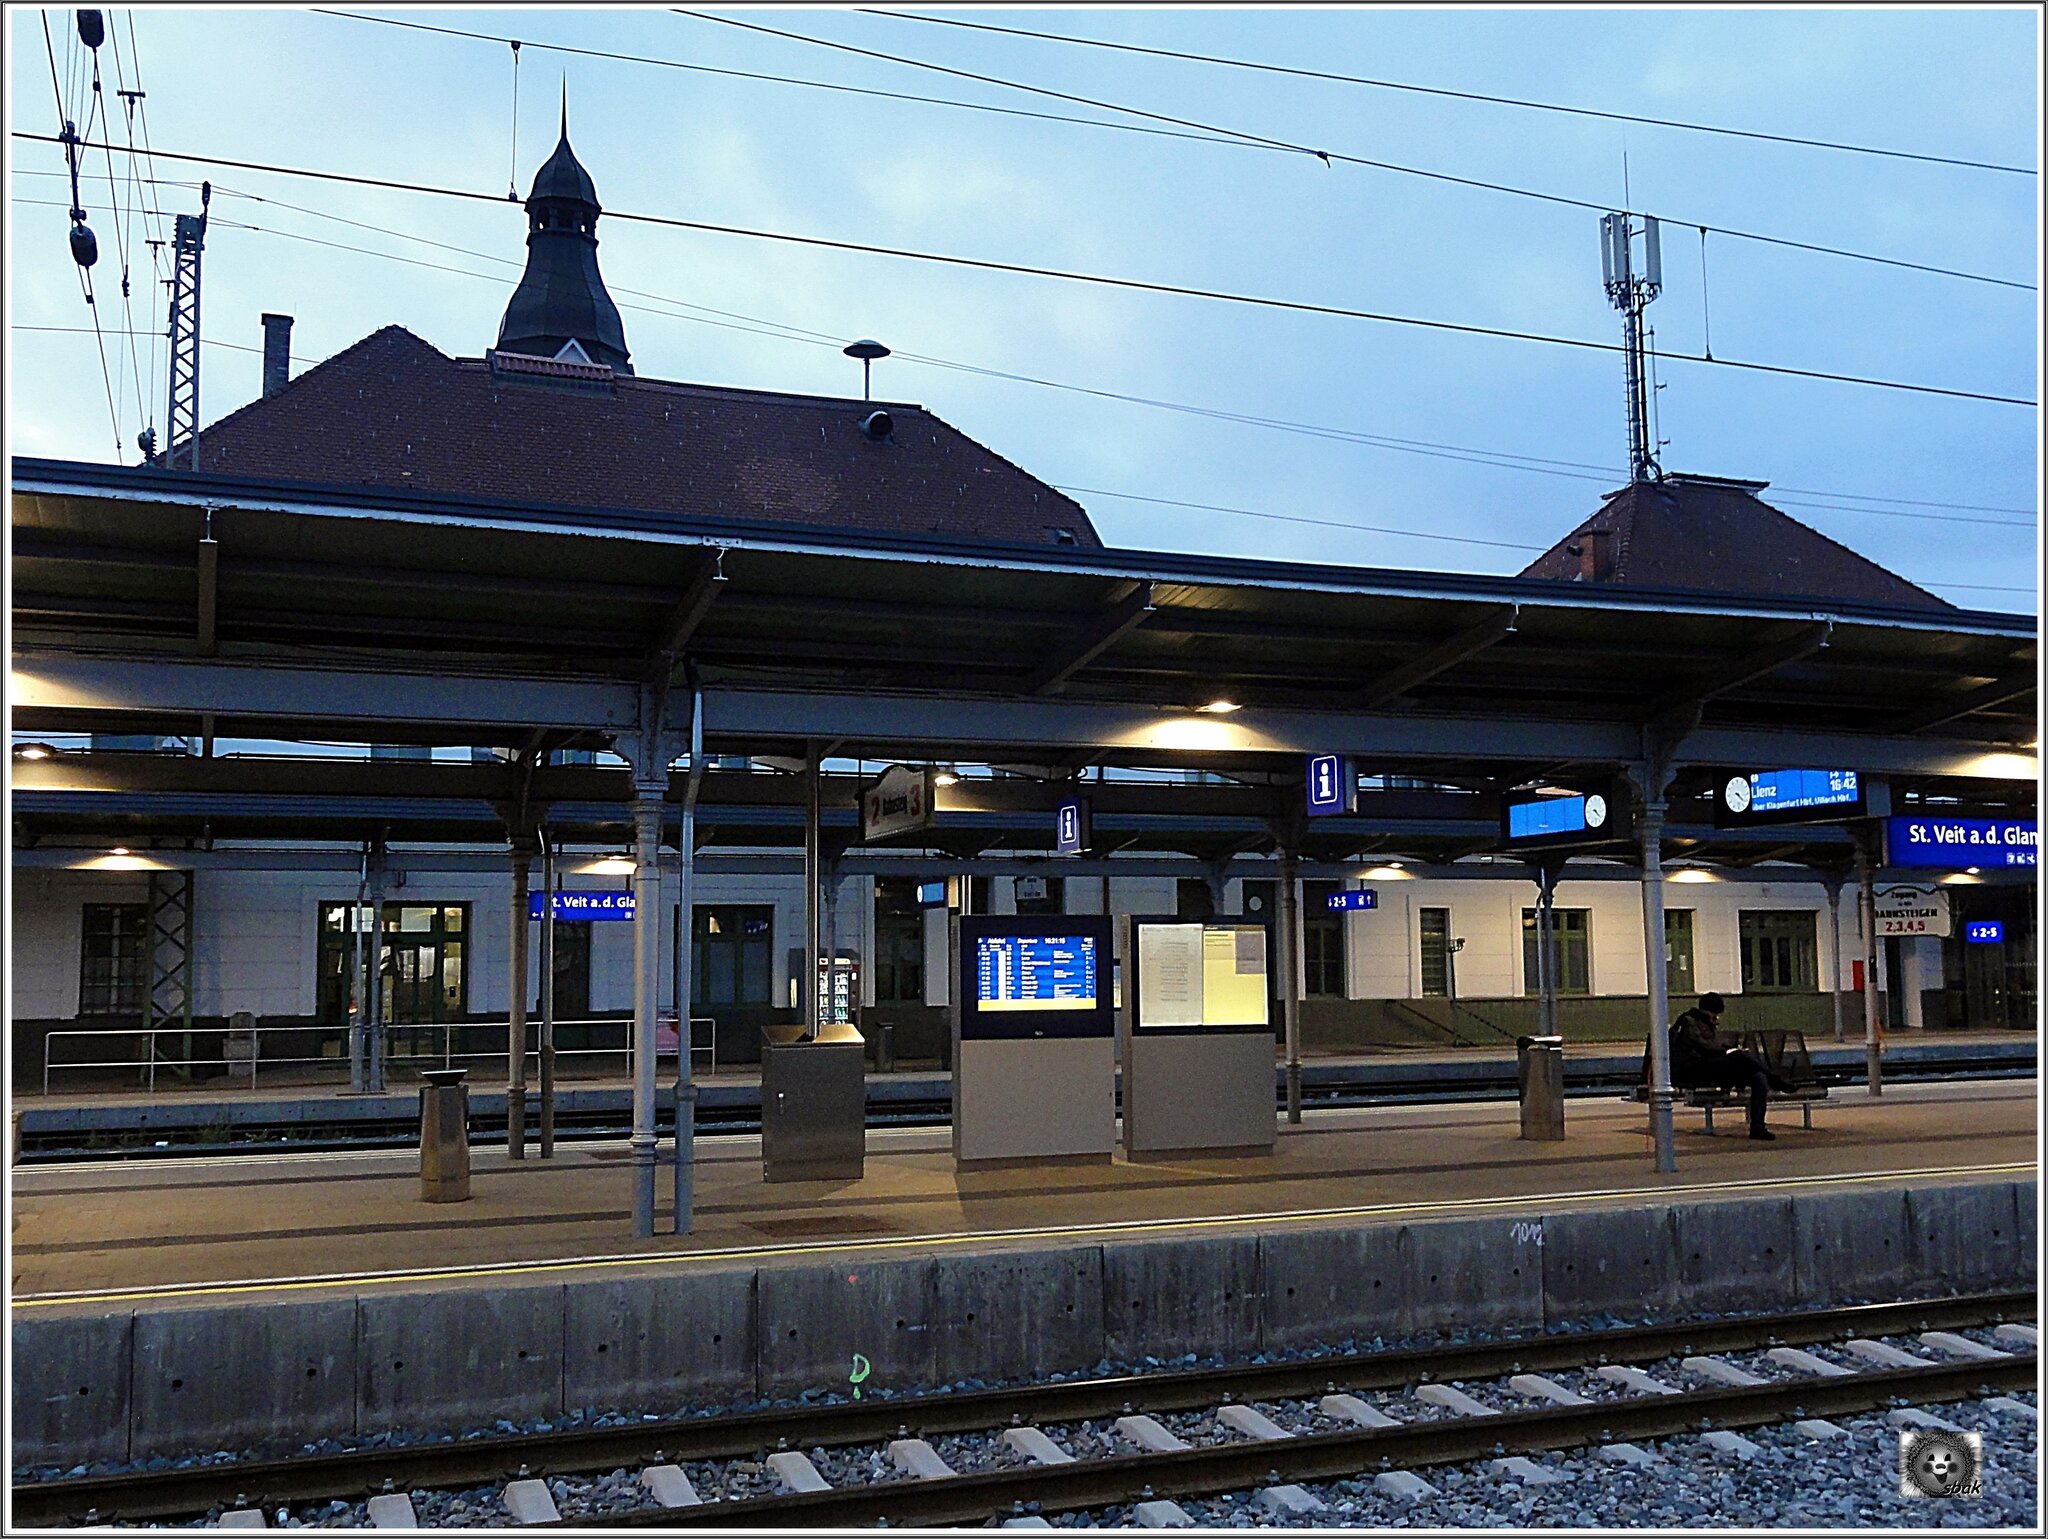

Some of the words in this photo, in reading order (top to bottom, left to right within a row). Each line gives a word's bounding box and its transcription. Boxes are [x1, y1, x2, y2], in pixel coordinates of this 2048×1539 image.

[1751, 786, 1777, 799] Lienz
[910, 783, 920, 816] 3
[1909, 825, 1931, 843] St.
[1933, 825, 1967, 844] Veit
[563, 896, 588, 908] Veit
[617, 896, 636, 908] Gla
[1979, 927, 1998, 938] 2-5
